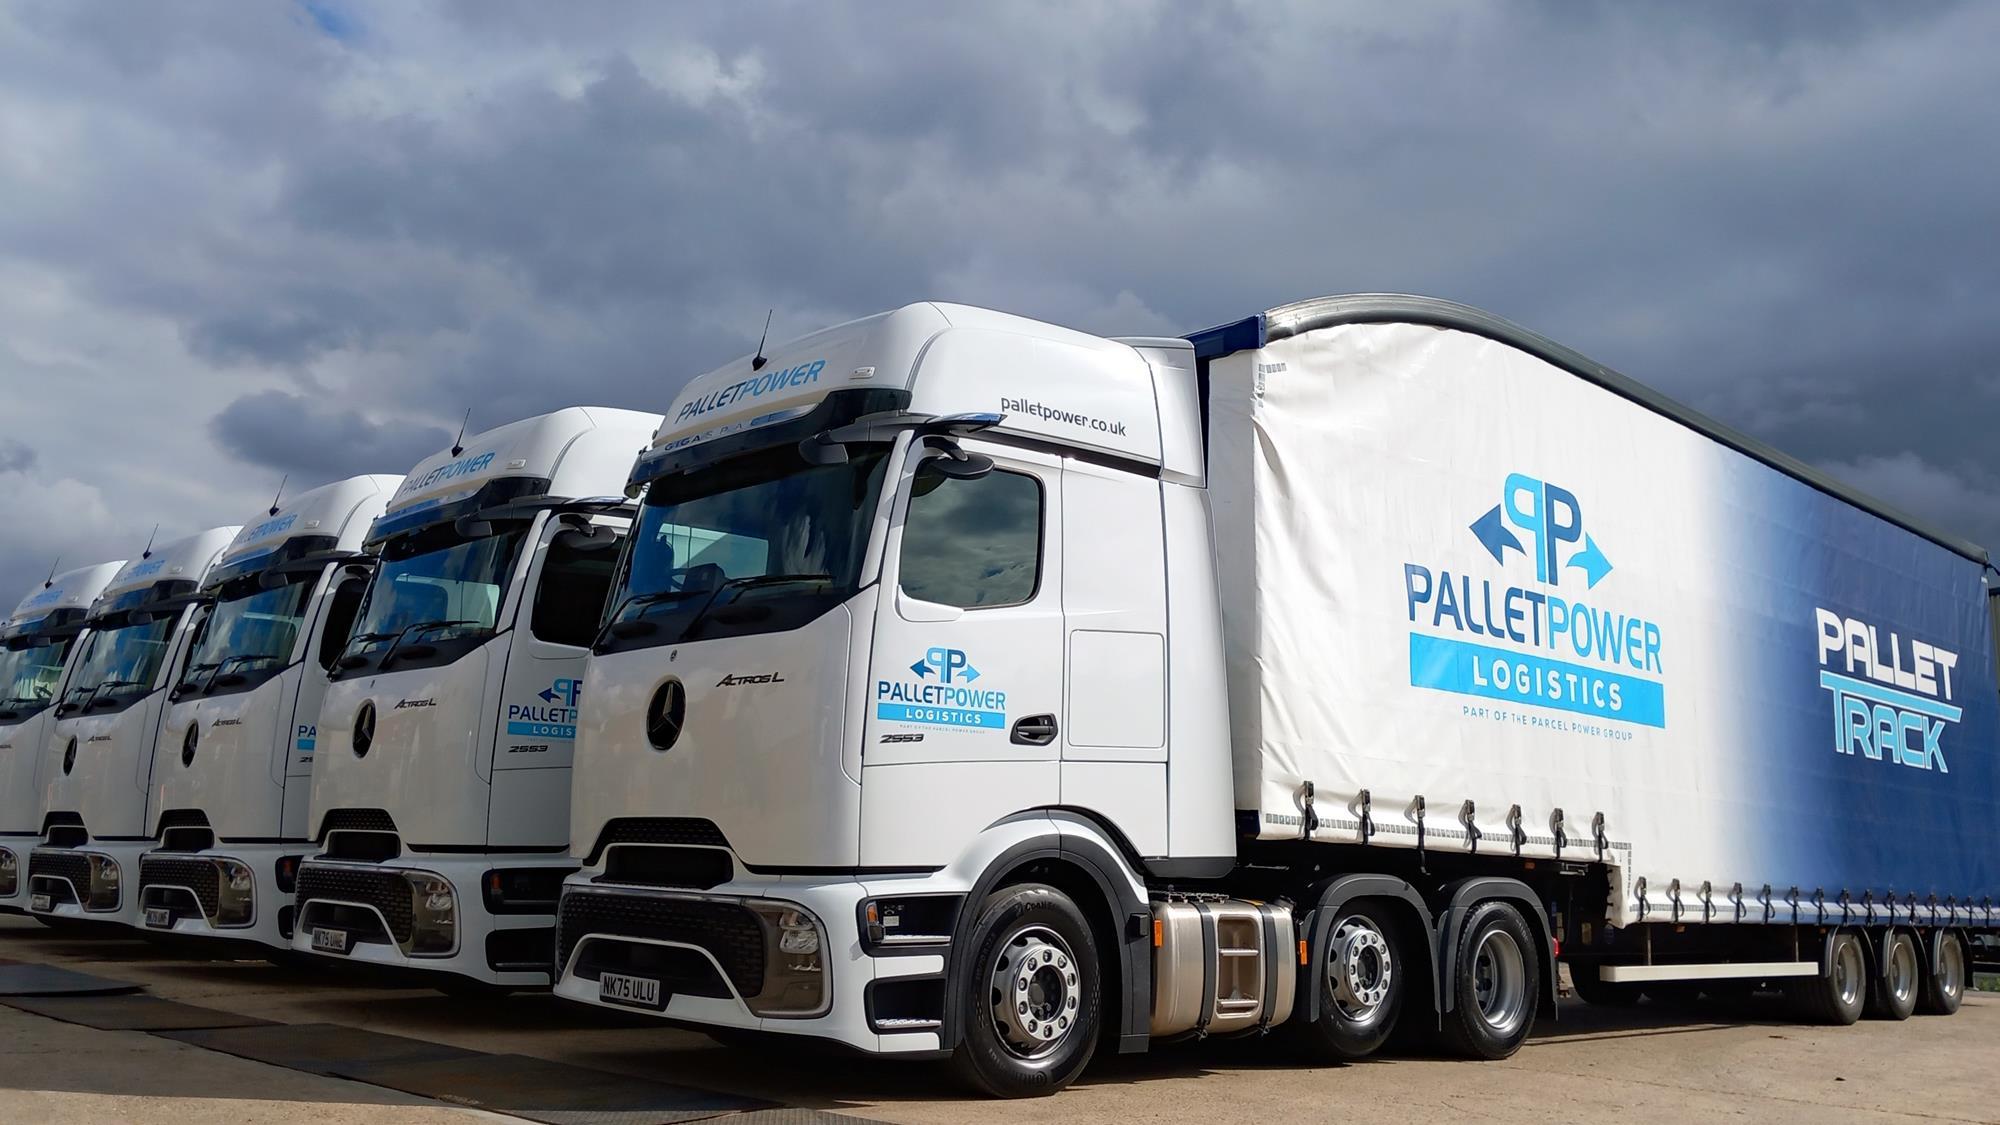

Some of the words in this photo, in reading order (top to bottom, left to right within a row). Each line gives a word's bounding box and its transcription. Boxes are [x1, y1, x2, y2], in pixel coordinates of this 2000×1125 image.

[674, 359, 826, 425] PALLETPOWER
[1000, 397, 1127, 437] palletpower.co.uk
[1404, 562, 1663, 674] PALLETPOWER
[1815, 607, 1958, 700] PALLET
[771, 671, 785, 683] L
[1473, 655, 1623, 712] LOGISTICS
[877, 681, 1007, 710] PALLETPOWER
[532, 724, 577, 737] LOGIS
[905, 708, 983, 725] LOGISTICS
[1463, 705, 1489, 720] PART
[1494, 710, 1507, 721] OF
[1511, 713, 1527, 725] THE
[1531, 716, 1568, 731] PARCEL
[1572, 722, 1601, 736] POWER
[1603, 728, 1633, 741] GROUP
[1820, 669, 1963, 774] TRACK
[507, 744, 549, 754] 2553
[879, 733, 925, 744] 2553
[602, 975, 631, 998] NK75
[631, 979, 655, 1002] ULU
